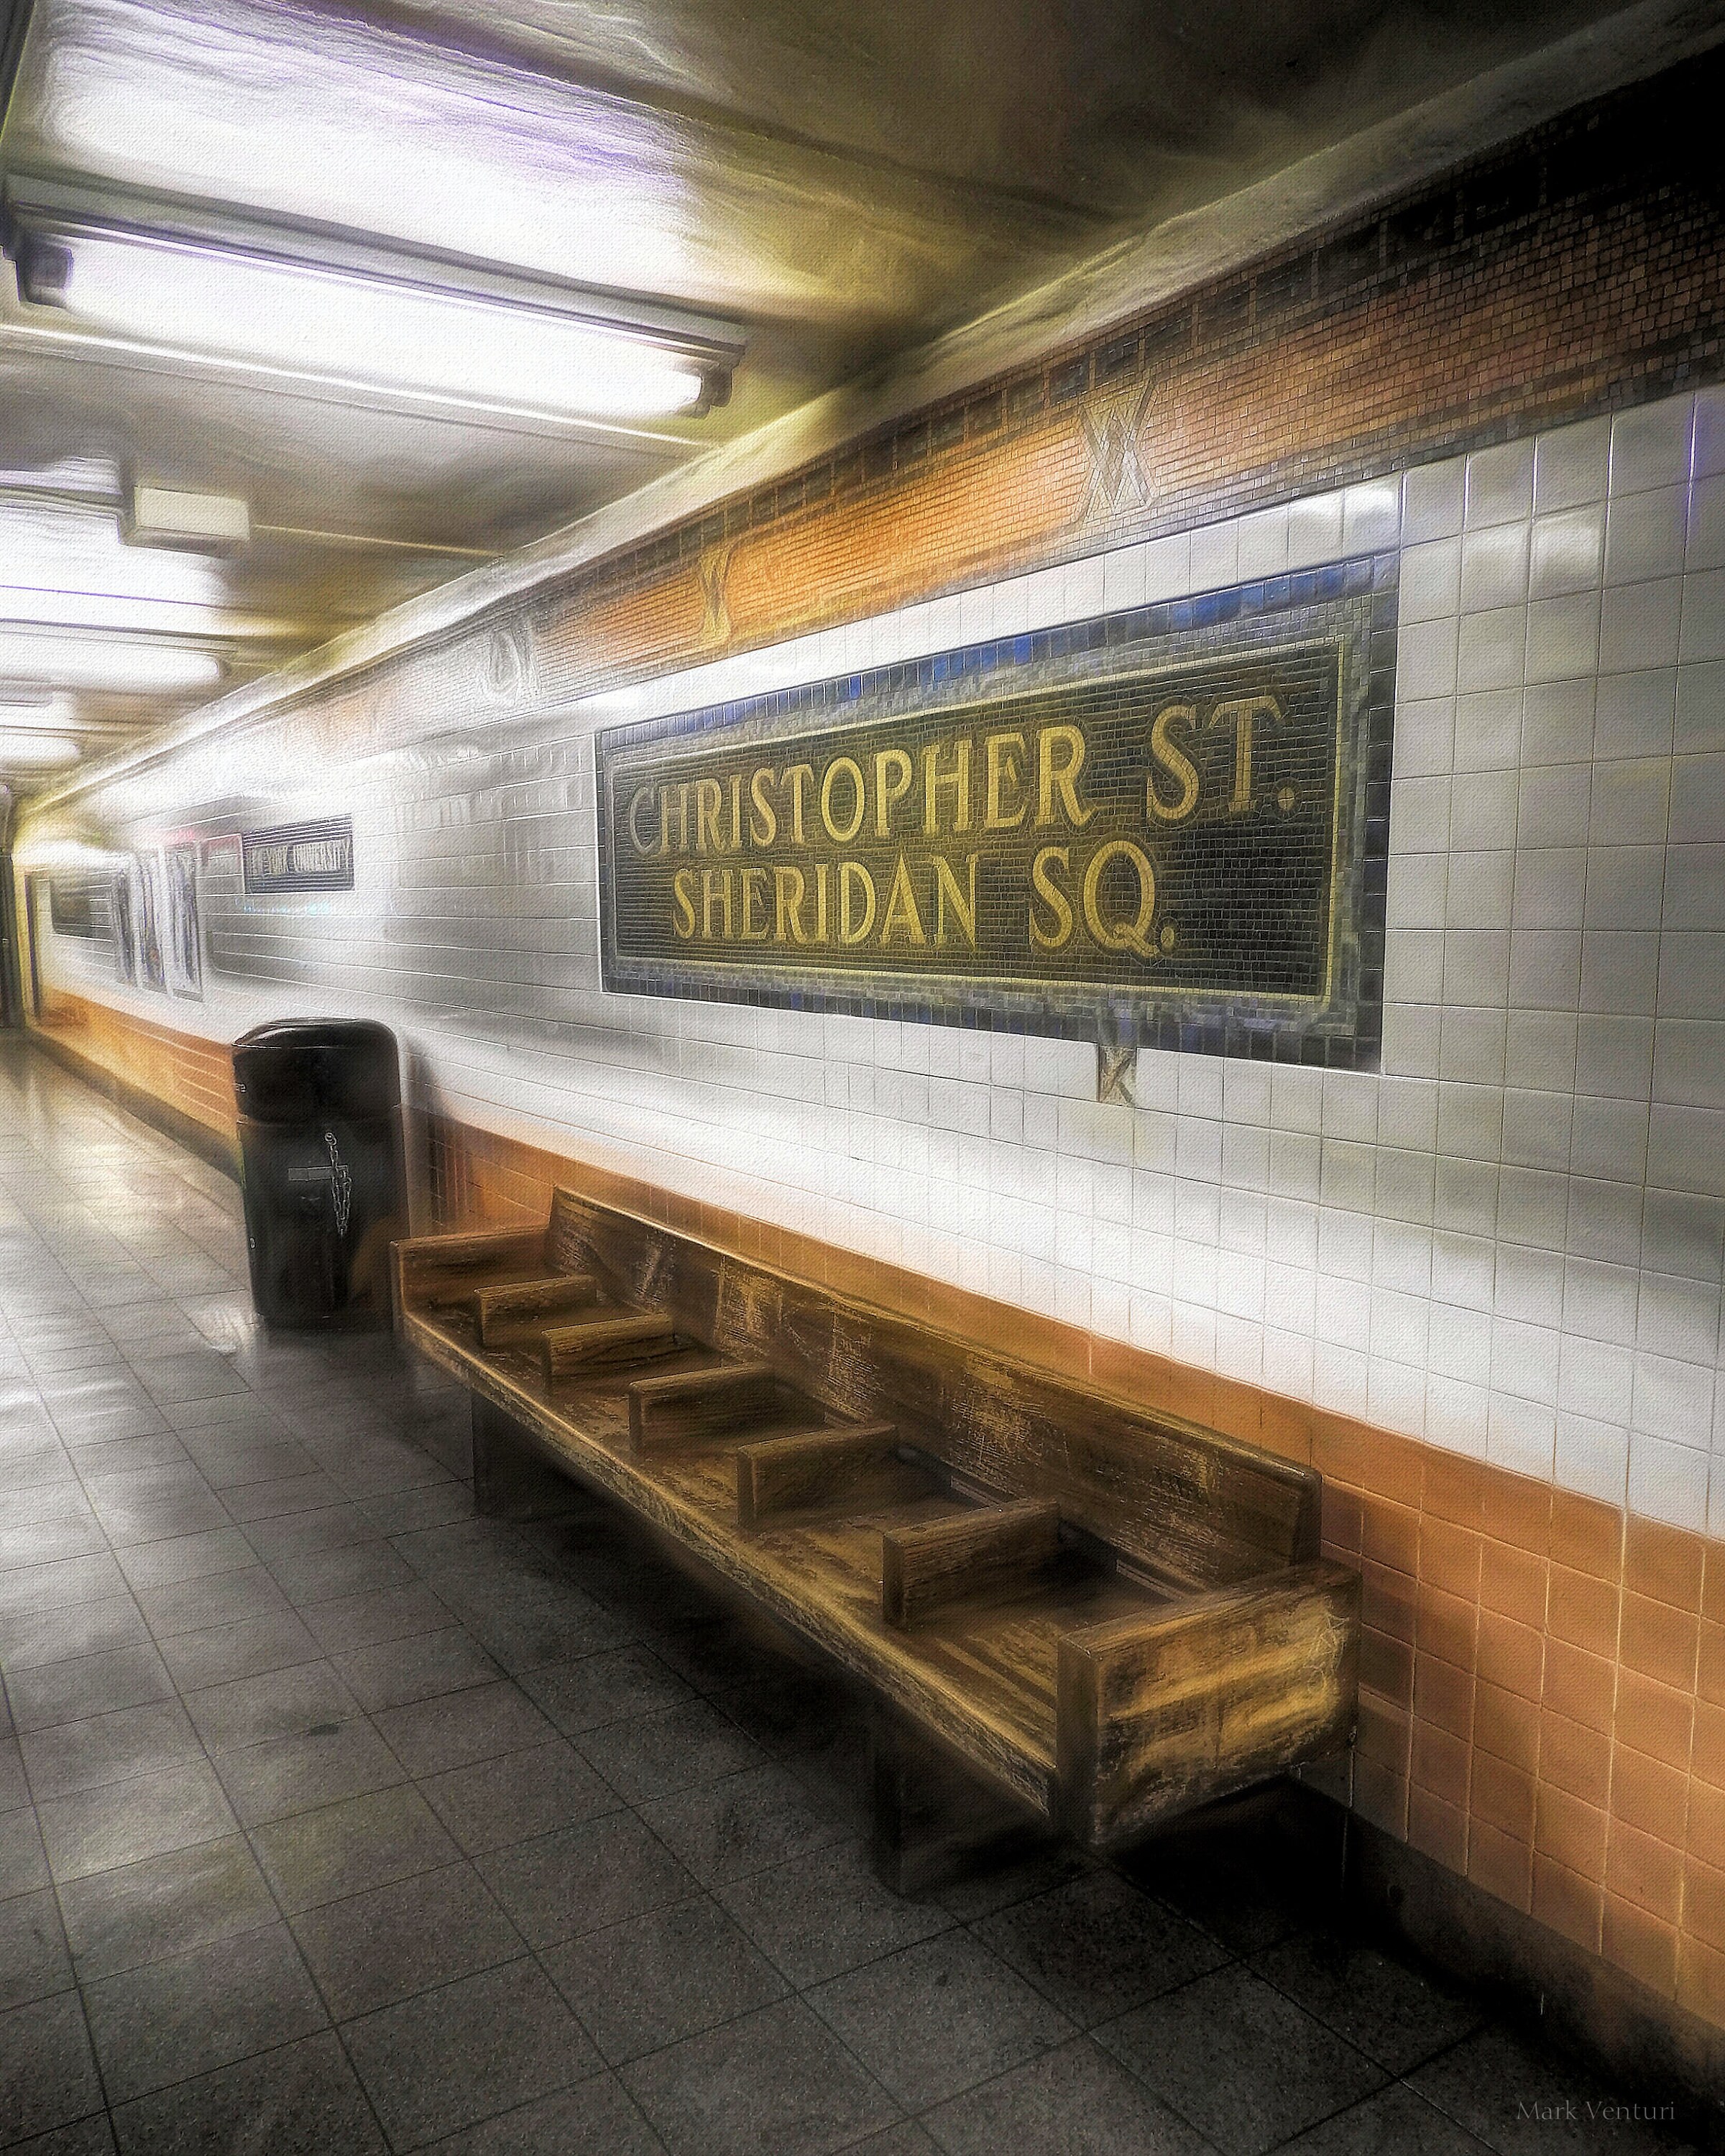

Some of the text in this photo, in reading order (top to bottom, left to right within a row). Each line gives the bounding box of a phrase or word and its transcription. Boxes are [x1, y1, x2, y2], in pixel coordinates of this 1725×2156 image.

[627, 694, 1296, 858] CHRISTOPHER ST.
[673, 840, 1175, 959] SHERIDAN SQ.
